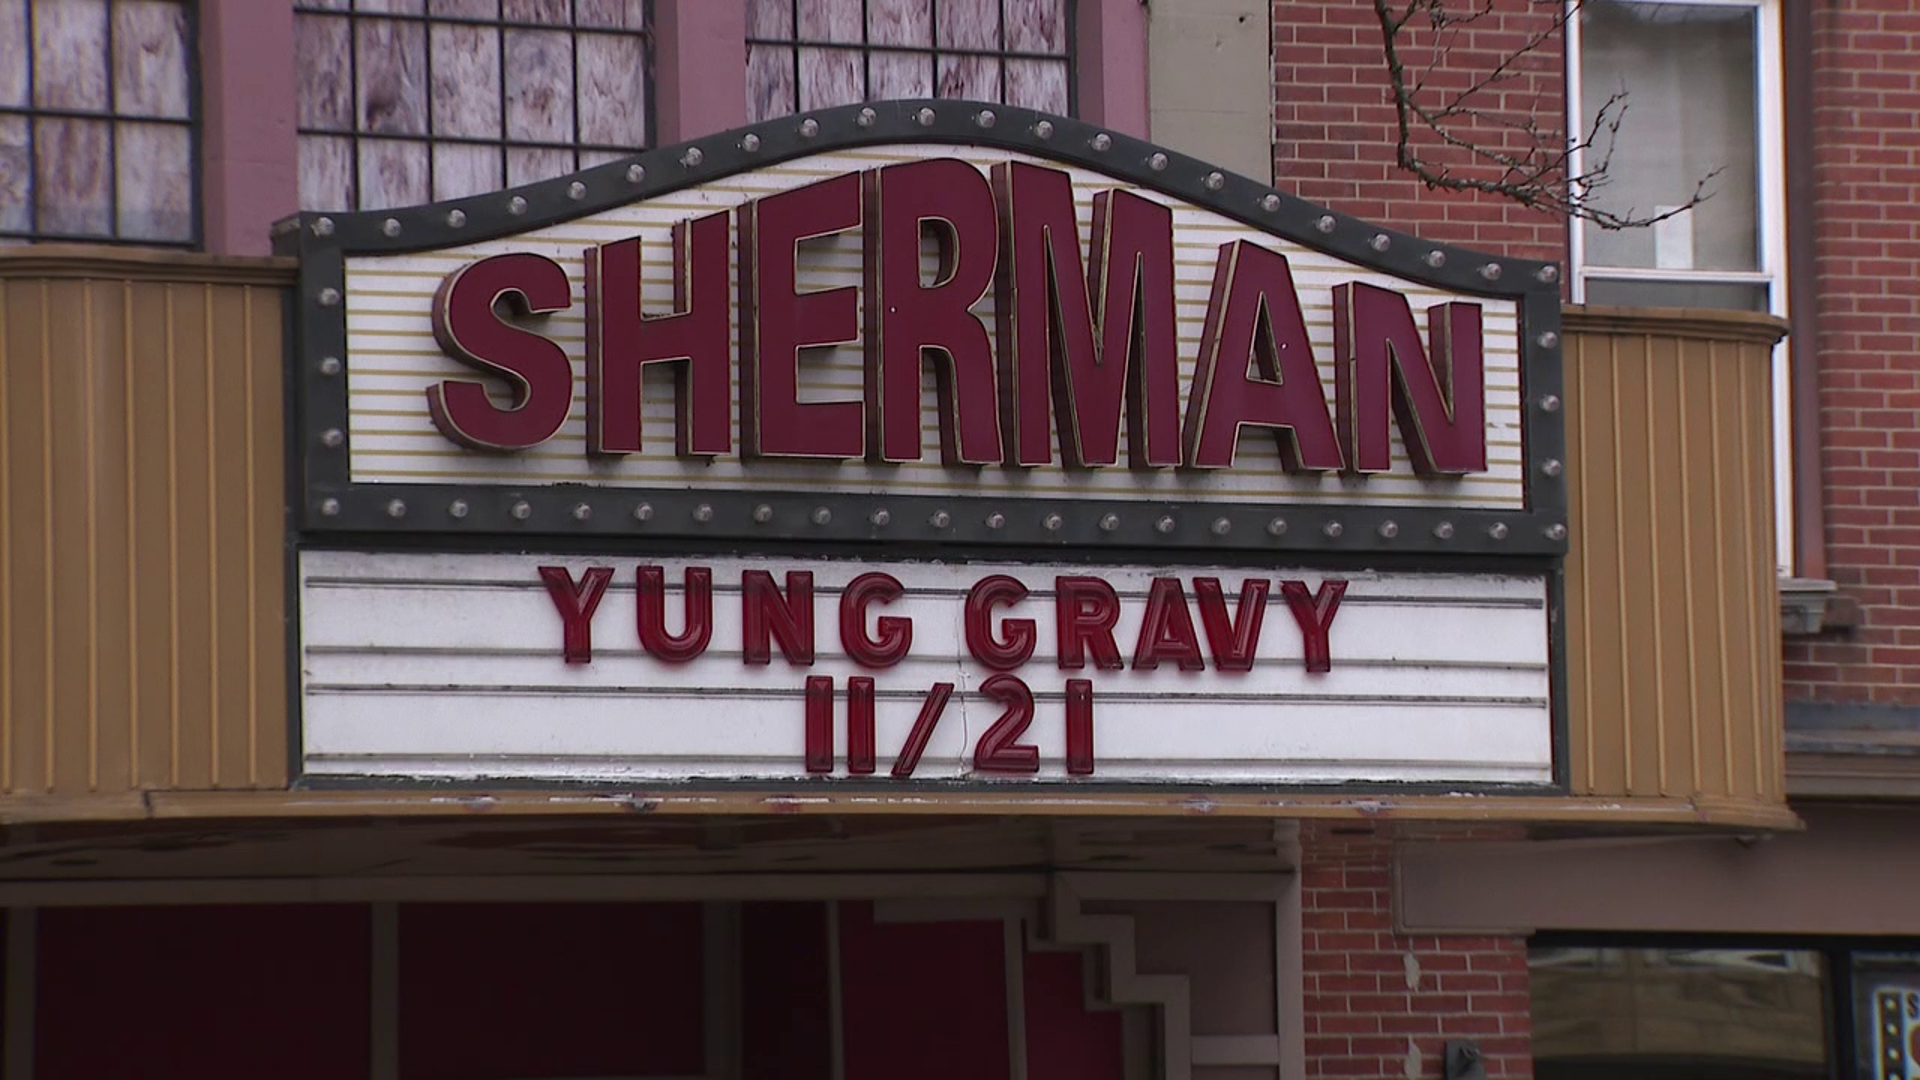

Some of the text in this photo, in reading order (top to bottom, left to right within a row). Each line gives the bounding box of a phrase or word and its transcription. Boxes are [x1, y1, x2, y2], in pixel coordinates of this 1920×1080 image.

[428, 157, 1487, 476] SHERMAN
[538, 565, 1349, 673] YUNG GRAVY
